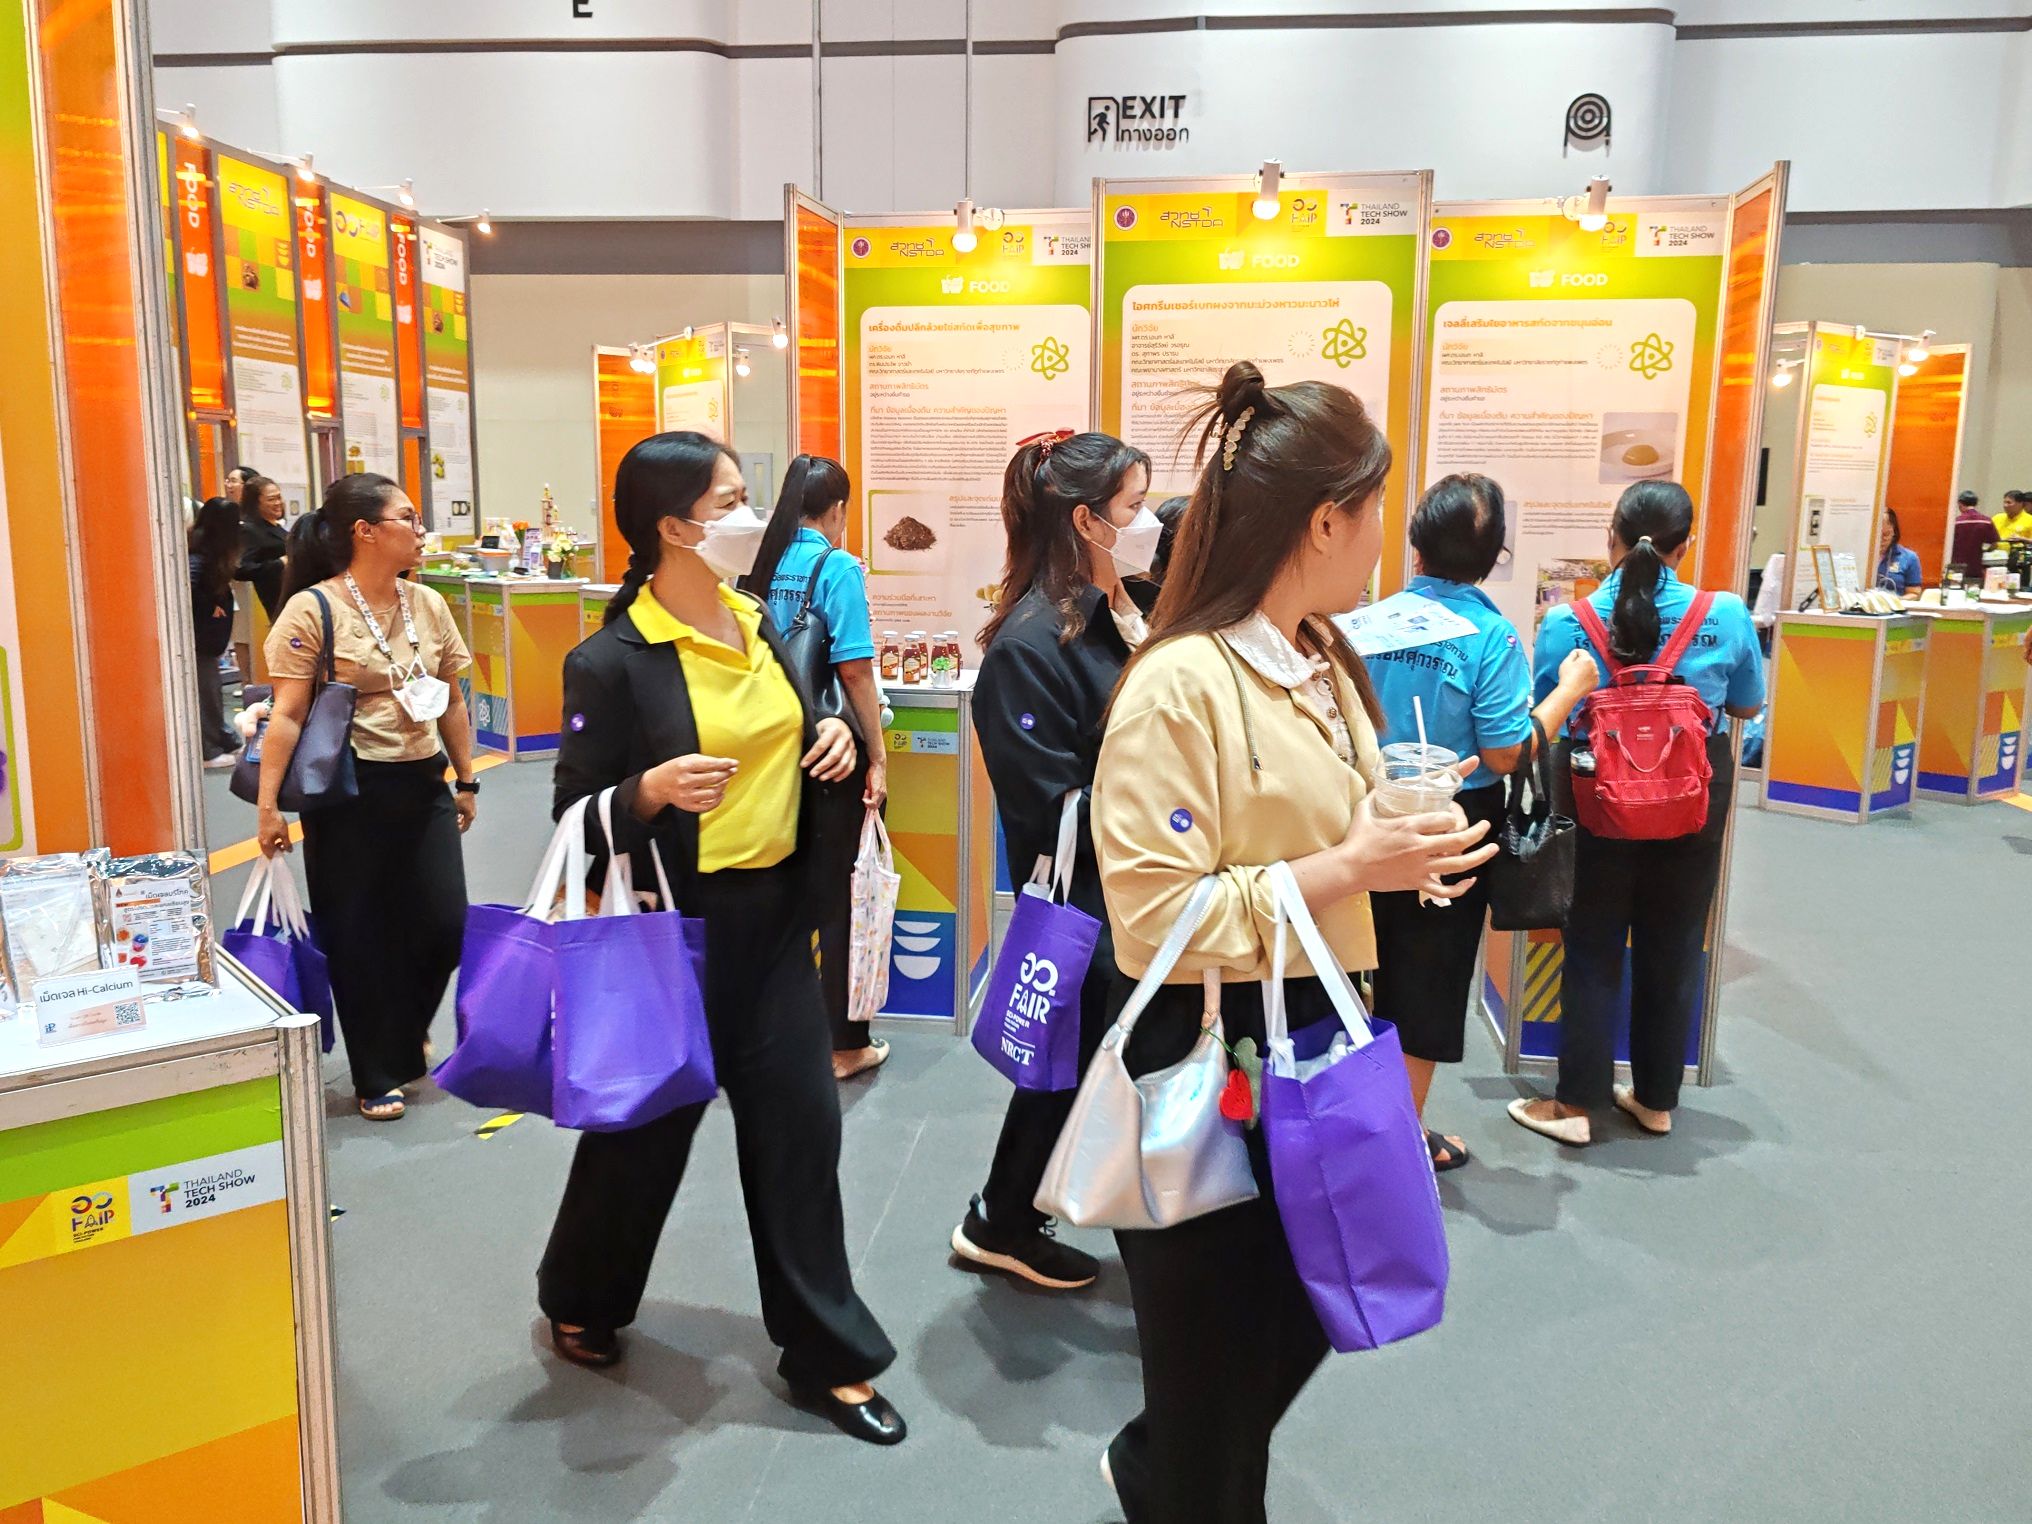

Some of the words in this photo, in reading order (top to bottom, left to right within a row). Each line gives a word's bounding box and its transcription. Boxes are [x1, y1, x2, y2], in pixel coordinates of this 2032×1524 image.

[1122, 95, 1187, 119] EXIT
[1121, 127, 1189, 143] ทางออก
[1361, 202, 1400, 210] THAILAND
[1383, 209, 1408, 217] SHOW
[1171, 219, 1224, 228] NSTDA
[1670, 225, 1708, 233] THAILAND
[1691, 231, 1715, 239] SHOW
[1251, 253, 1300, 268] FOOD
[969, 280, 1010, 293] FOOD
[1560, 273, 1608, 287] FOOD
[40, 990, 76, 1003] เม็ดเจล
[77, 981, 133, 996] Hi-Calcium
[1008, 983, 1050, 1024] FAIR
[1001, 1036, 1035, 1066] NRCT
[184, 1169, 243, 1190] THAILAND
[185, 1184, 216, 1199] TECH
[218, 1174, 256, 1191] SHOW
[185, 1194, 217, 1208] 2024
